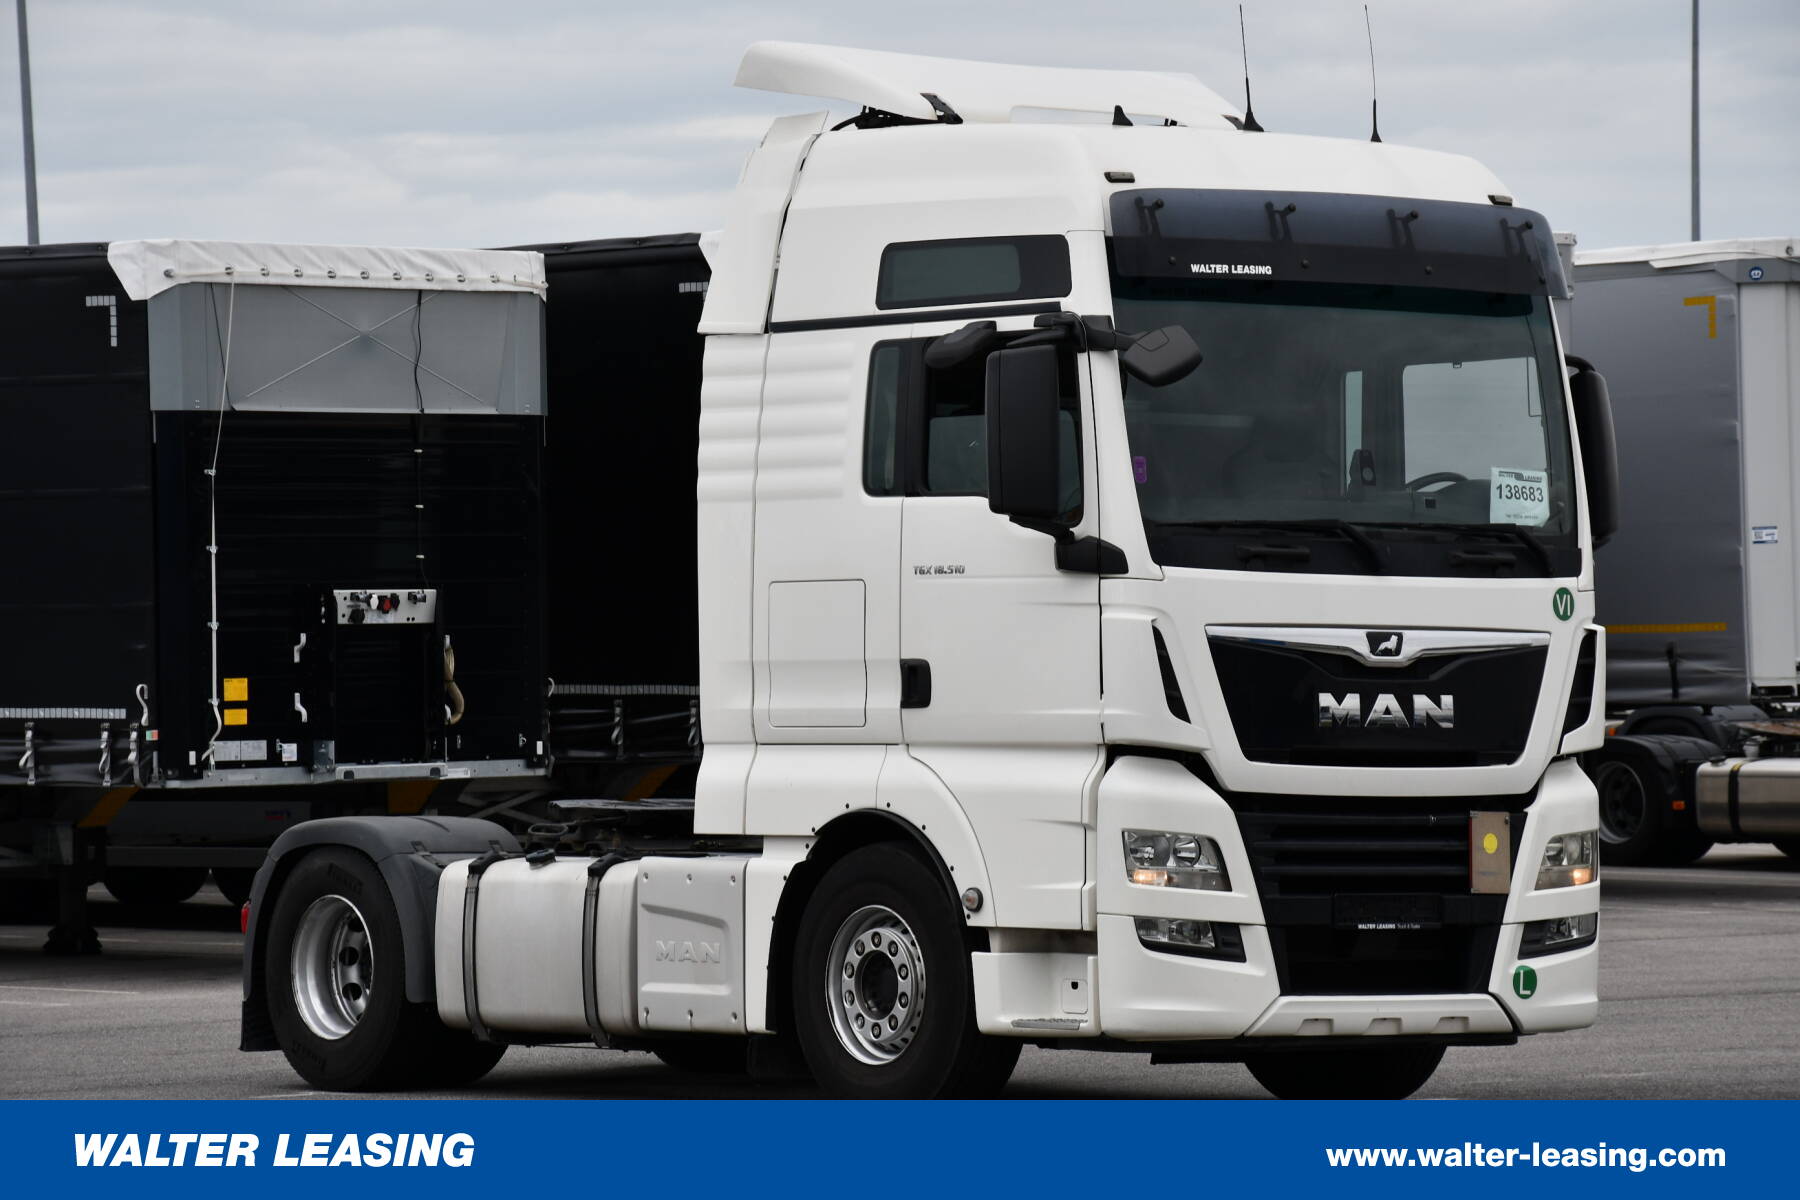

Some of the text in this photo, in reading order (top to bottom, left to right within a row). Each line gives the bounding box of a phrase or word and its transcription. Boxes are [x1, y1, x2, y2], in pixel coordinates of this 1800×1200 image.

[1190, 263, 1272, 275] WALTER LEASING
[1496, 483, 1544, 502] 138683
[912, 564, 933, 575] TGX
[1555, 593, 1571, 617] VI
[1318, 692, 1454, 728] MAN
[655, 940, 721, 964] MAN
[1519, 969, 1532, 995] L
